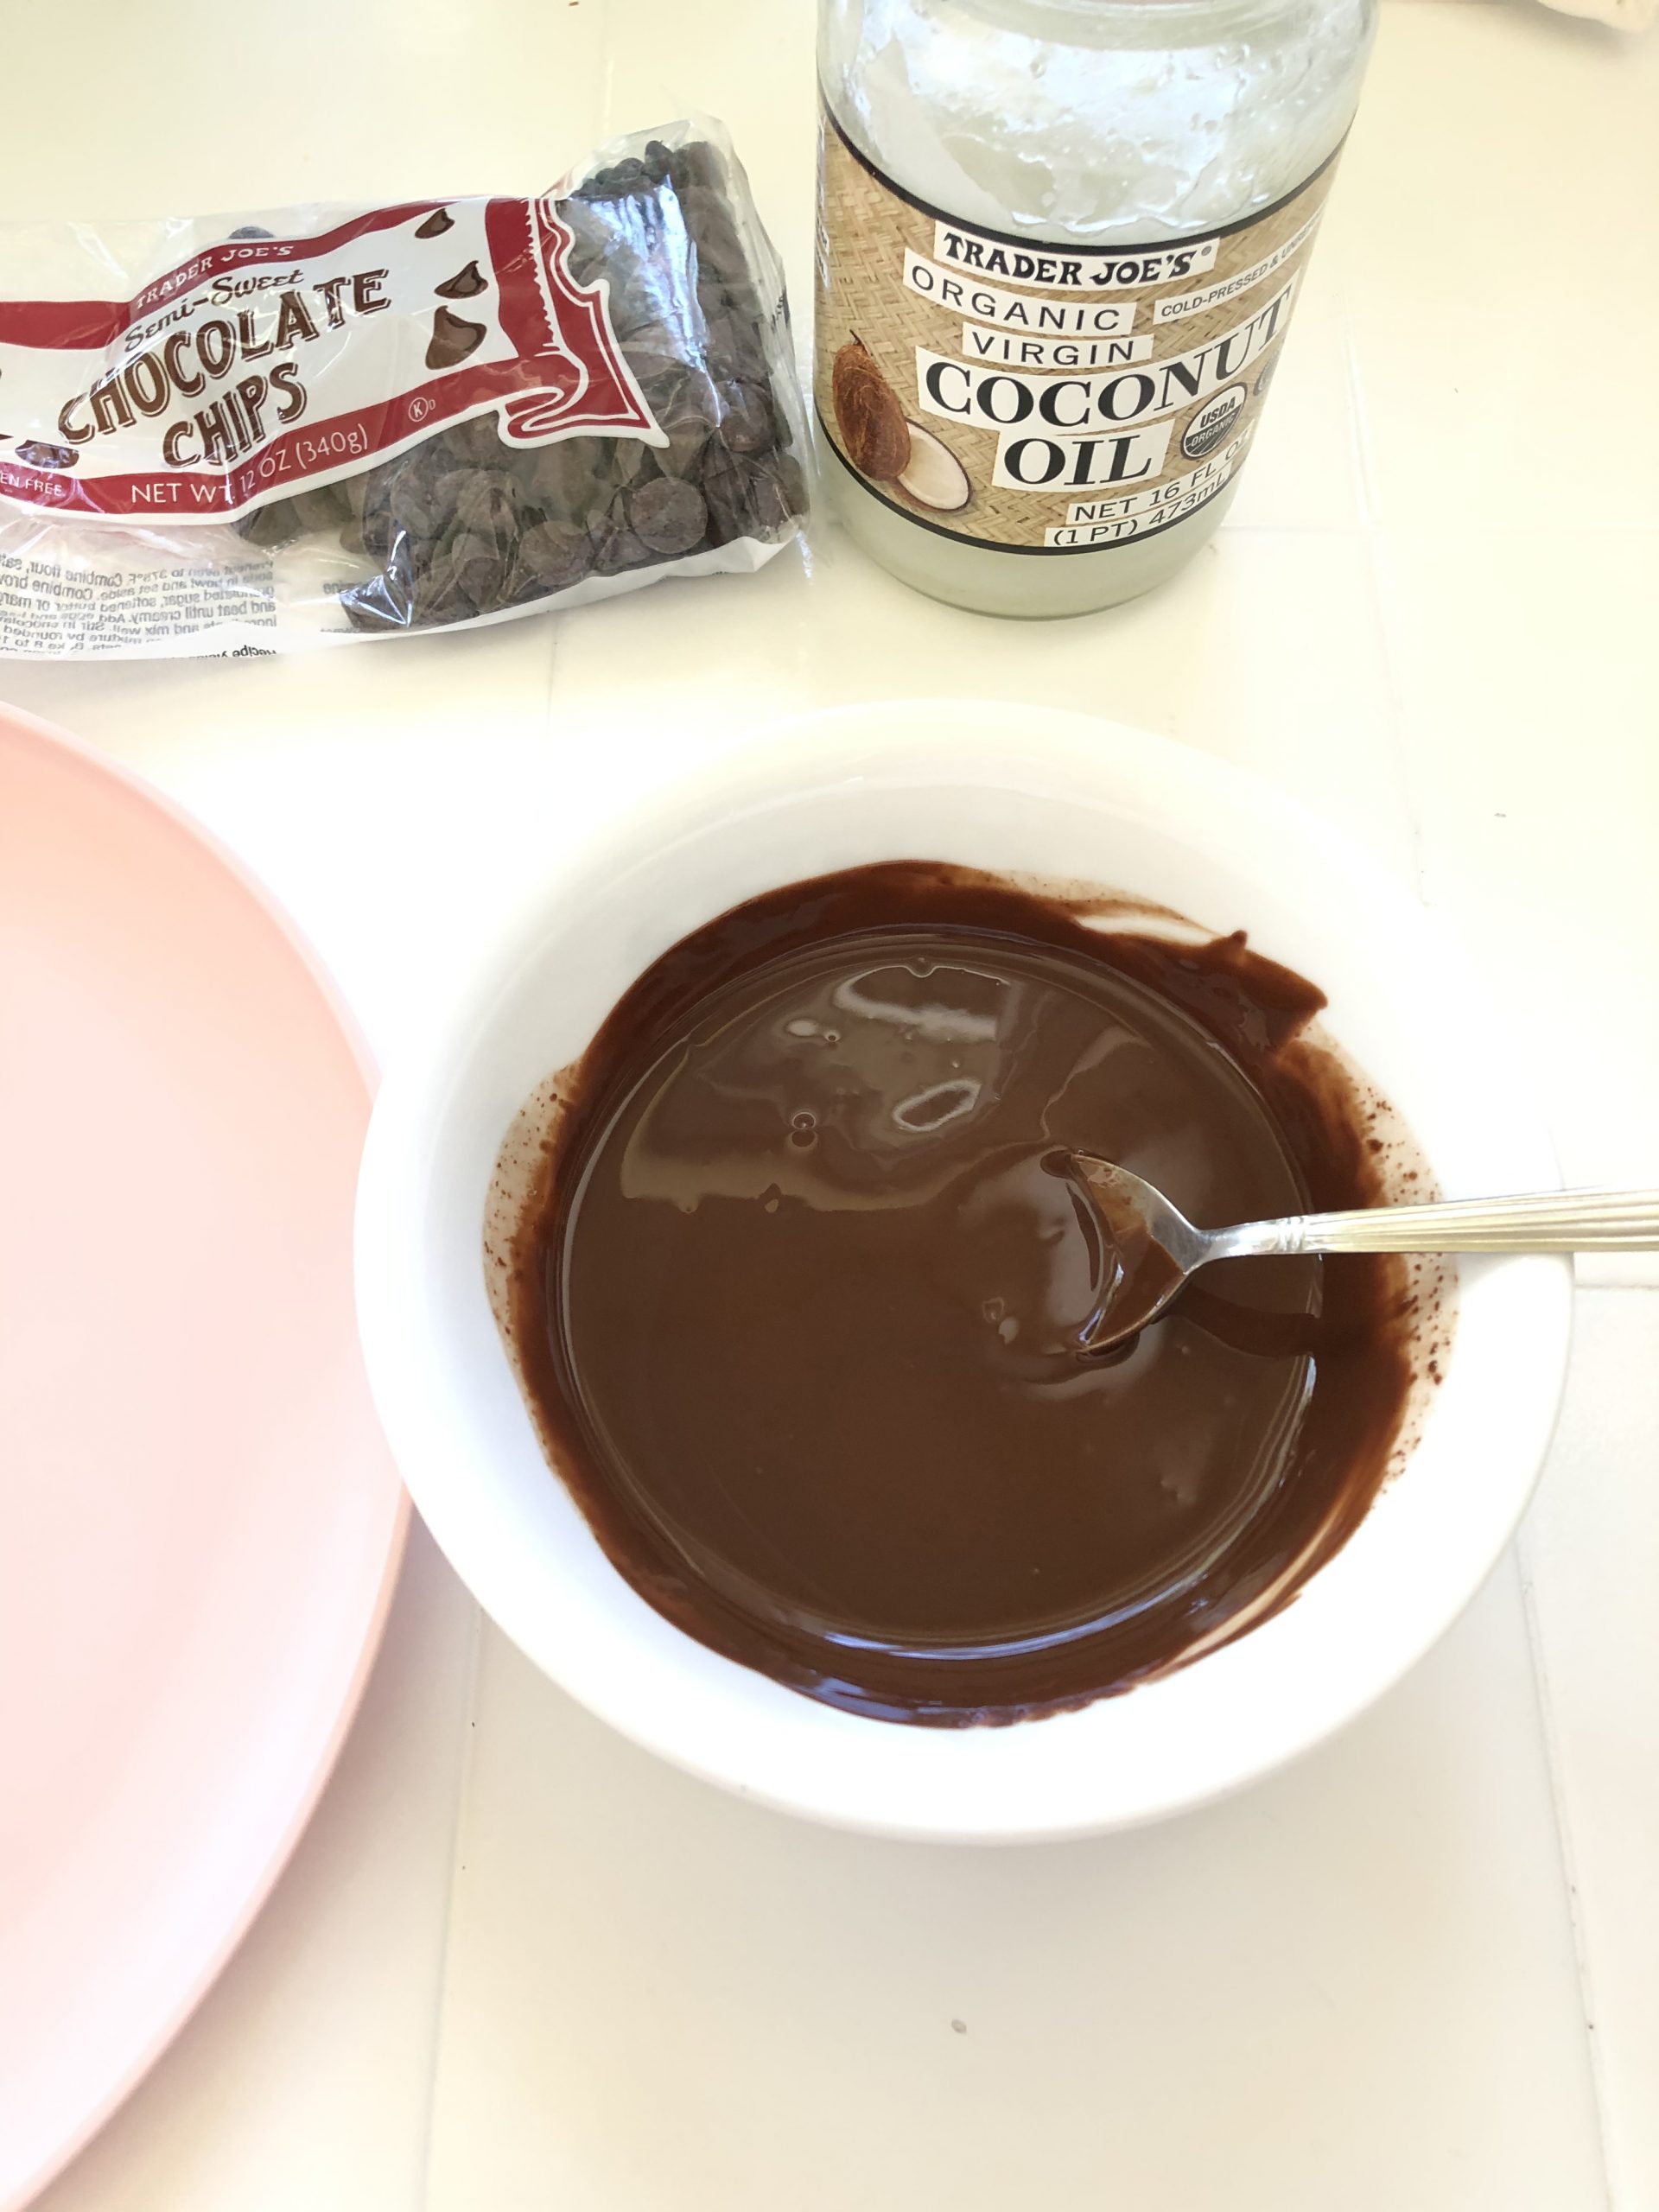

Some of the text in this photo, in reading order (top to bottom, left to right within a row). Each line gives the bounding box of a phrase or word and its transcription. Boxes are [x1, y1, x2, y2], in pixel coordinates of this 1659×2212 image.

[135, 245, 294, 309] TRADER JOE'S
[942, 232, 1083, 286] TRADER
[911, 264, 1121, 332] ORGANIC
[1160, 264, 1268, 318] COLD-PRESSED
[58, 268, 392, 444] CHOCOLATE
[925, 284, 1293, 428] COCONUT
[971, 332, 1134, 366] VIRGIN
[162, 362, 308, 468] CHIPS
[1191, 412, 1237, 448] ORGANIC
[1200, 397, 1236, 428] USDA
[25, 478, 66, 497] FREE
[131, 483, 182, 504] NET
[239, 469, 256, 494] 12
[259, 448, 291, 477] OZ
[296, 423, 368, 469] (340g)
[1004, 434, 1152, 486] OIL
[1053, 472, 1227, 546] (1 PT) 473mL
[1074, 498, 1138, 522] NET
[1148, 480, 1179, 506] 16
[1191, 461, 1217, 487] FL
